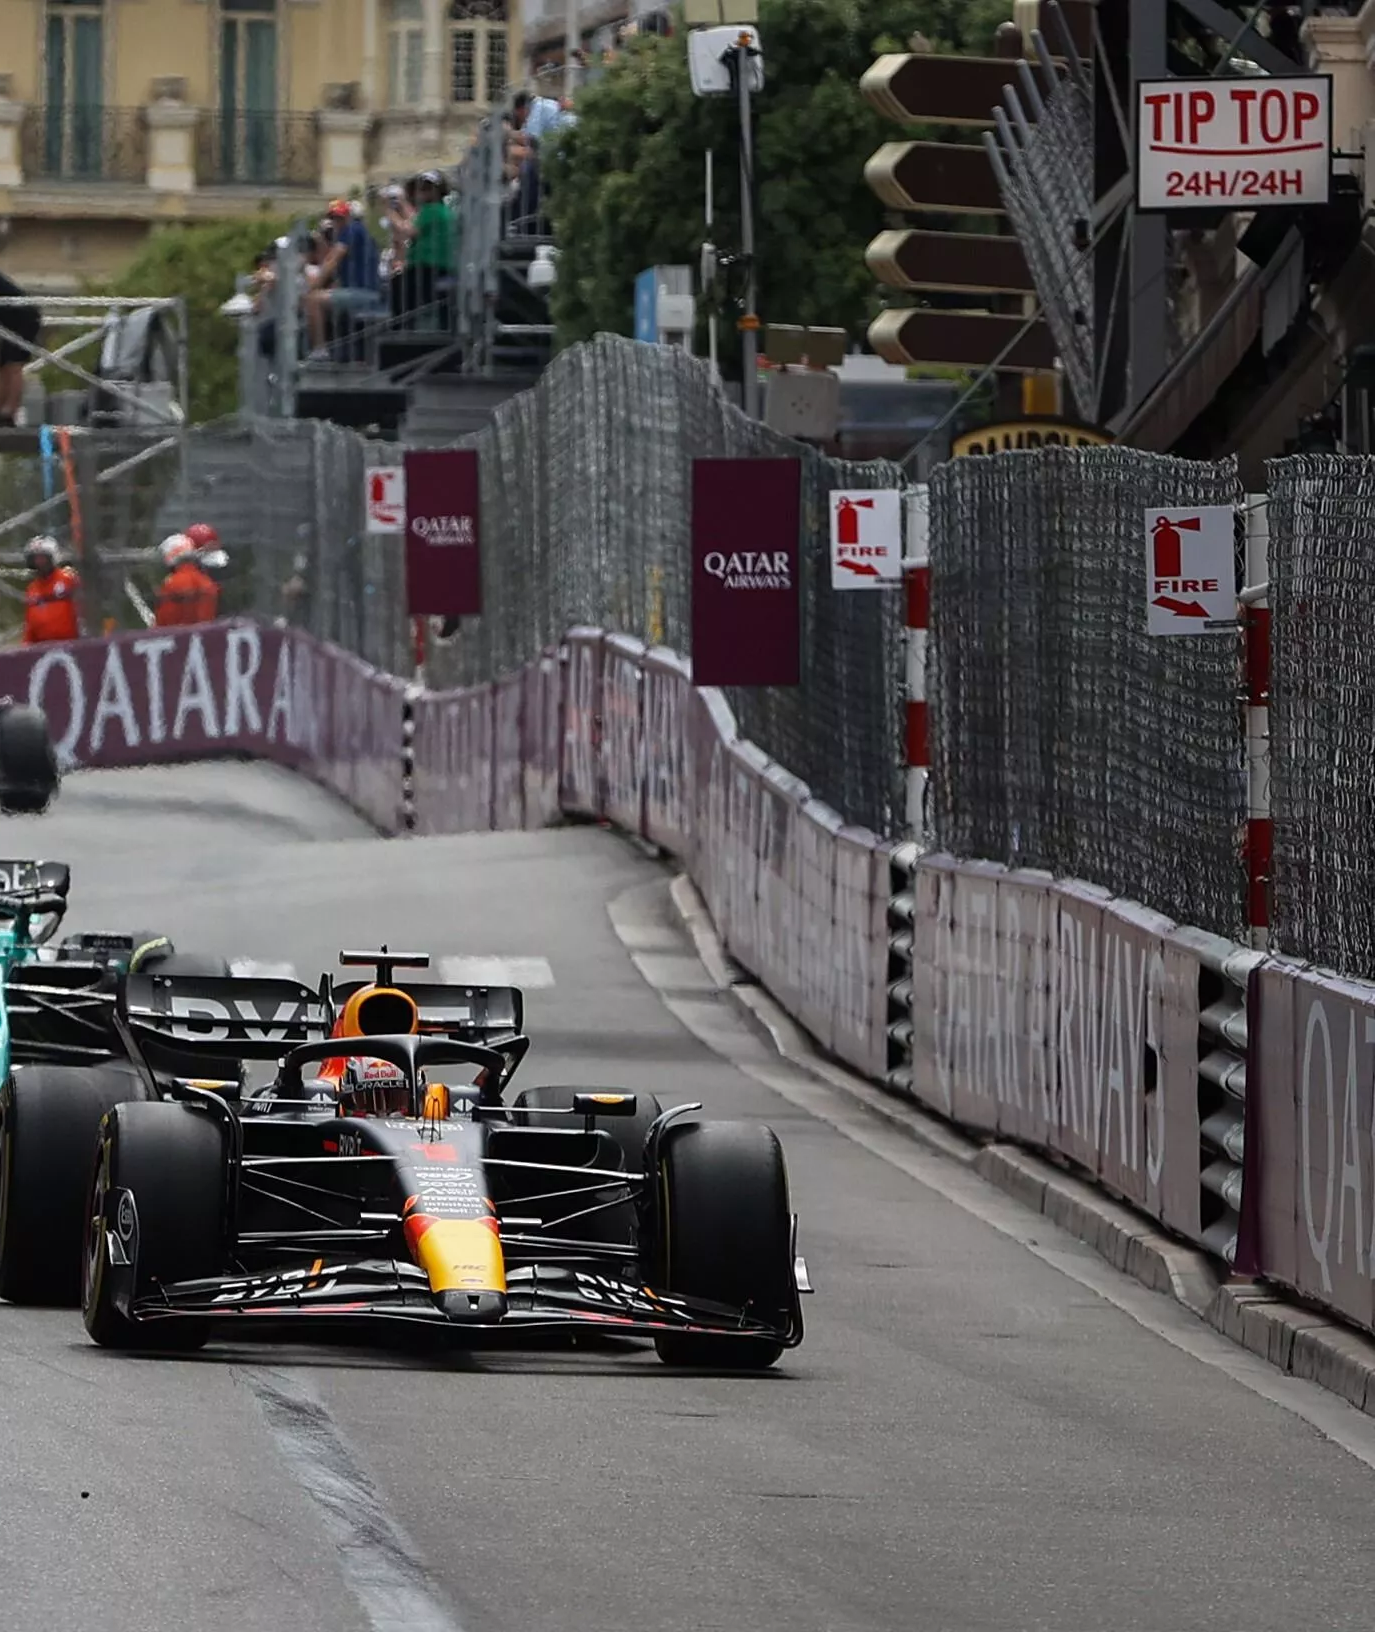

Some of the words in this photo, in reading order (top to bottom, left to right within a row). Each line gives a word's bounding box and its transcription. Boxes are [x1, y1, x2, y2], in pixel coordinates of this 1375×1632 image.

[1144, 90, 1215, 145] TIP
[1230, 88, 1320, 145] TOP
[1166, 168, 1302, 197] 24H/24H
[411, 515, 474, 538] QATAR
[838, 546, 889, 557] FIRE
[704, 551, 789, 579] QATAR
[724, 574, 792, 590] AIRWAYS
[1153, 578, 1219, 594] FIRE
[29, 628, 263, 771] QATAR
[934, 872, 1021, 1113] QATAR
[1028, 898, 1166, 1187] AIRWAYS
[364, 1070, 380, 1079] Red
[381, 1070, 397, 1078] Bull
